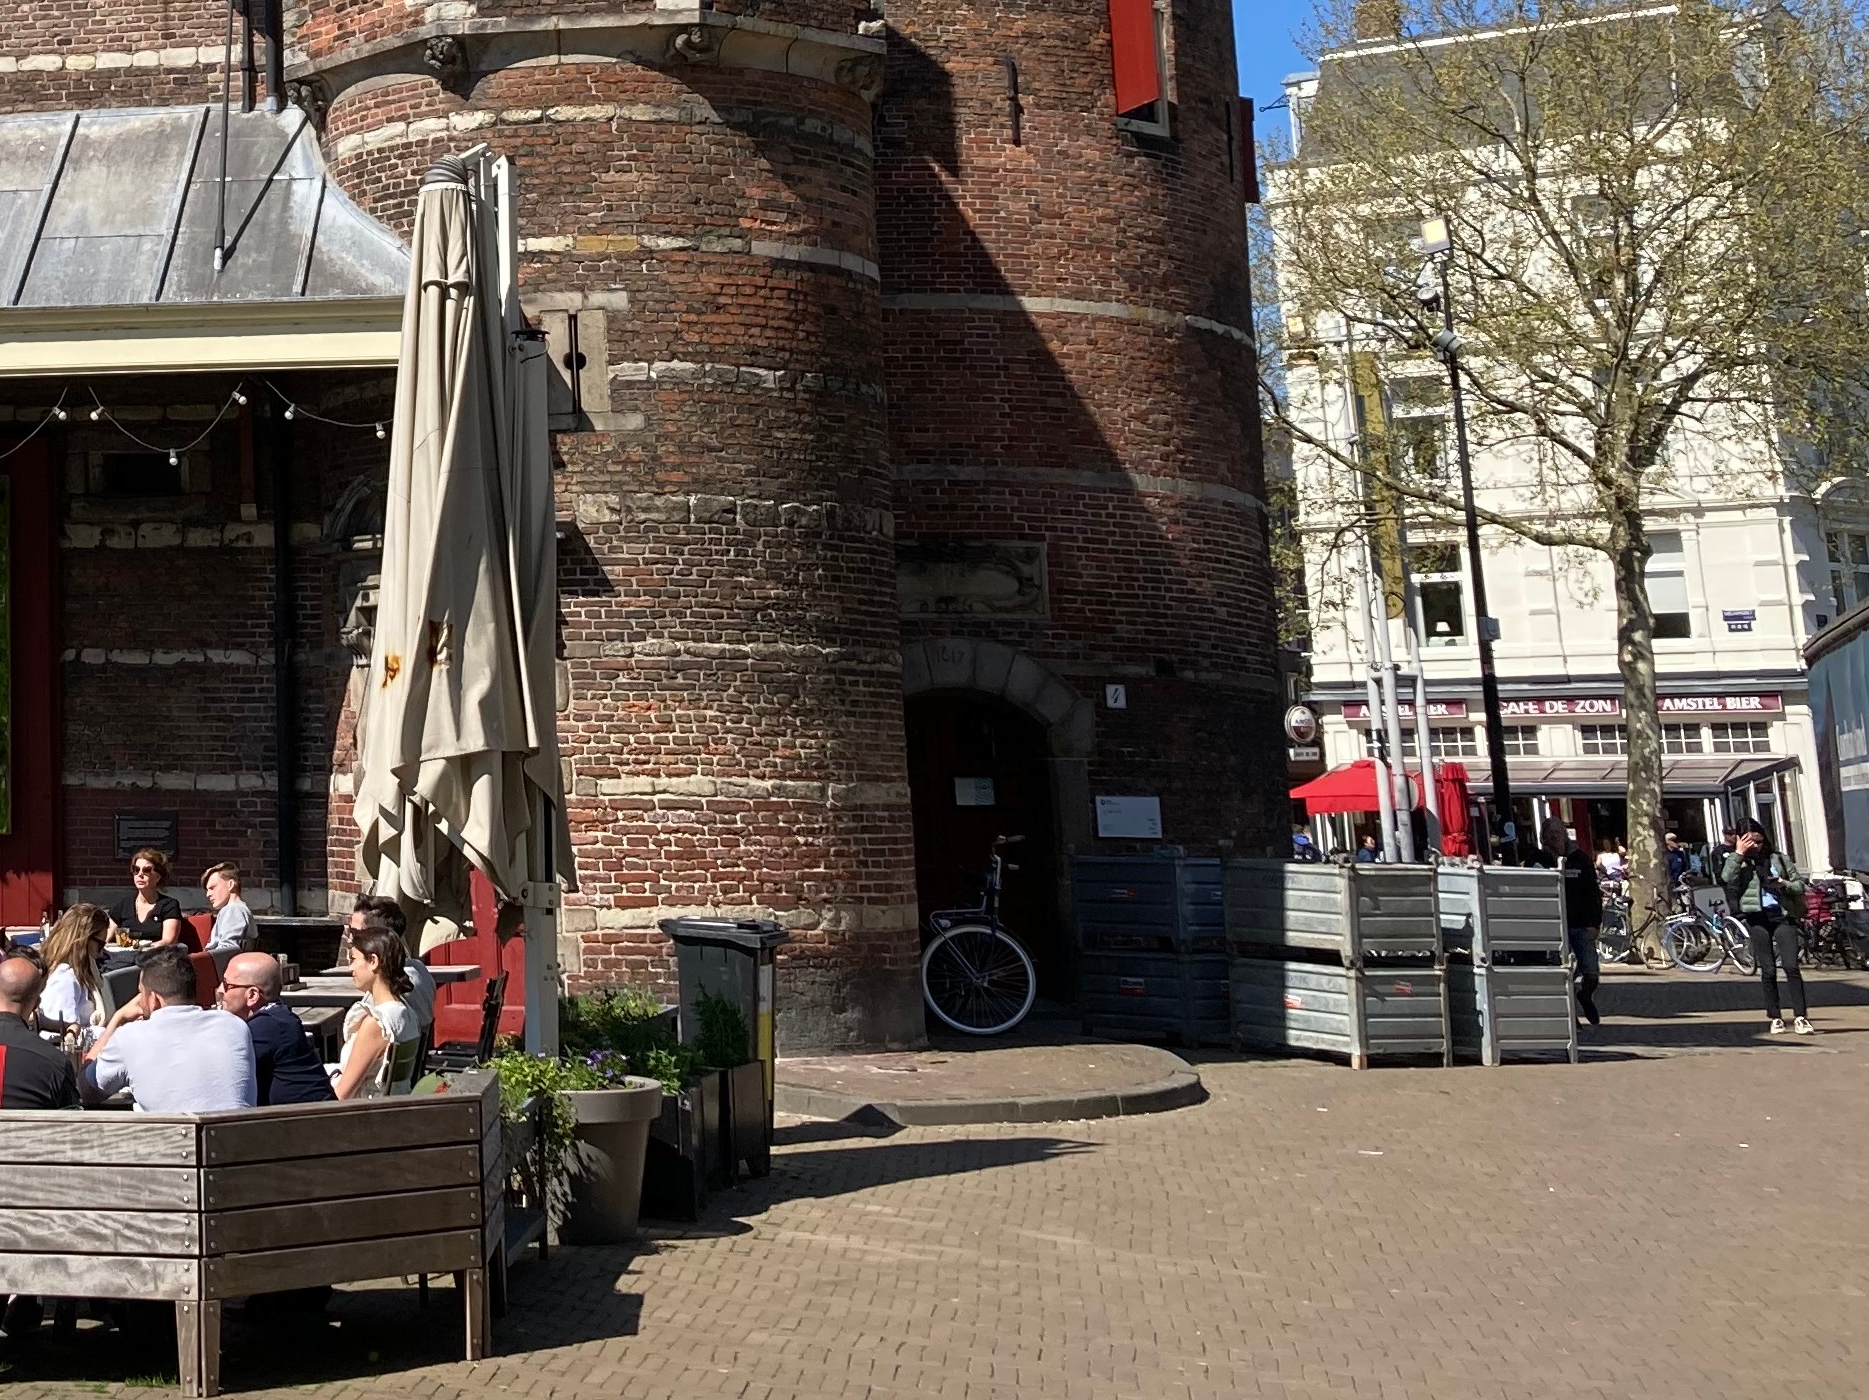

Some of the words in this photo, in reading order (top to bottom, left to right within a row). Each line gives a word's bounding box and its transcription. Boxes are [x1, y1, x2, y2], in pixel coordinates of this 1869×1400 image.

[1545, 699, 1569, 714] DE
[1574, 699, 1612, 713] ZON
[1662, 696, 1723, 711] AMSTEL
[1725, 695, 1763, 710] BIER
